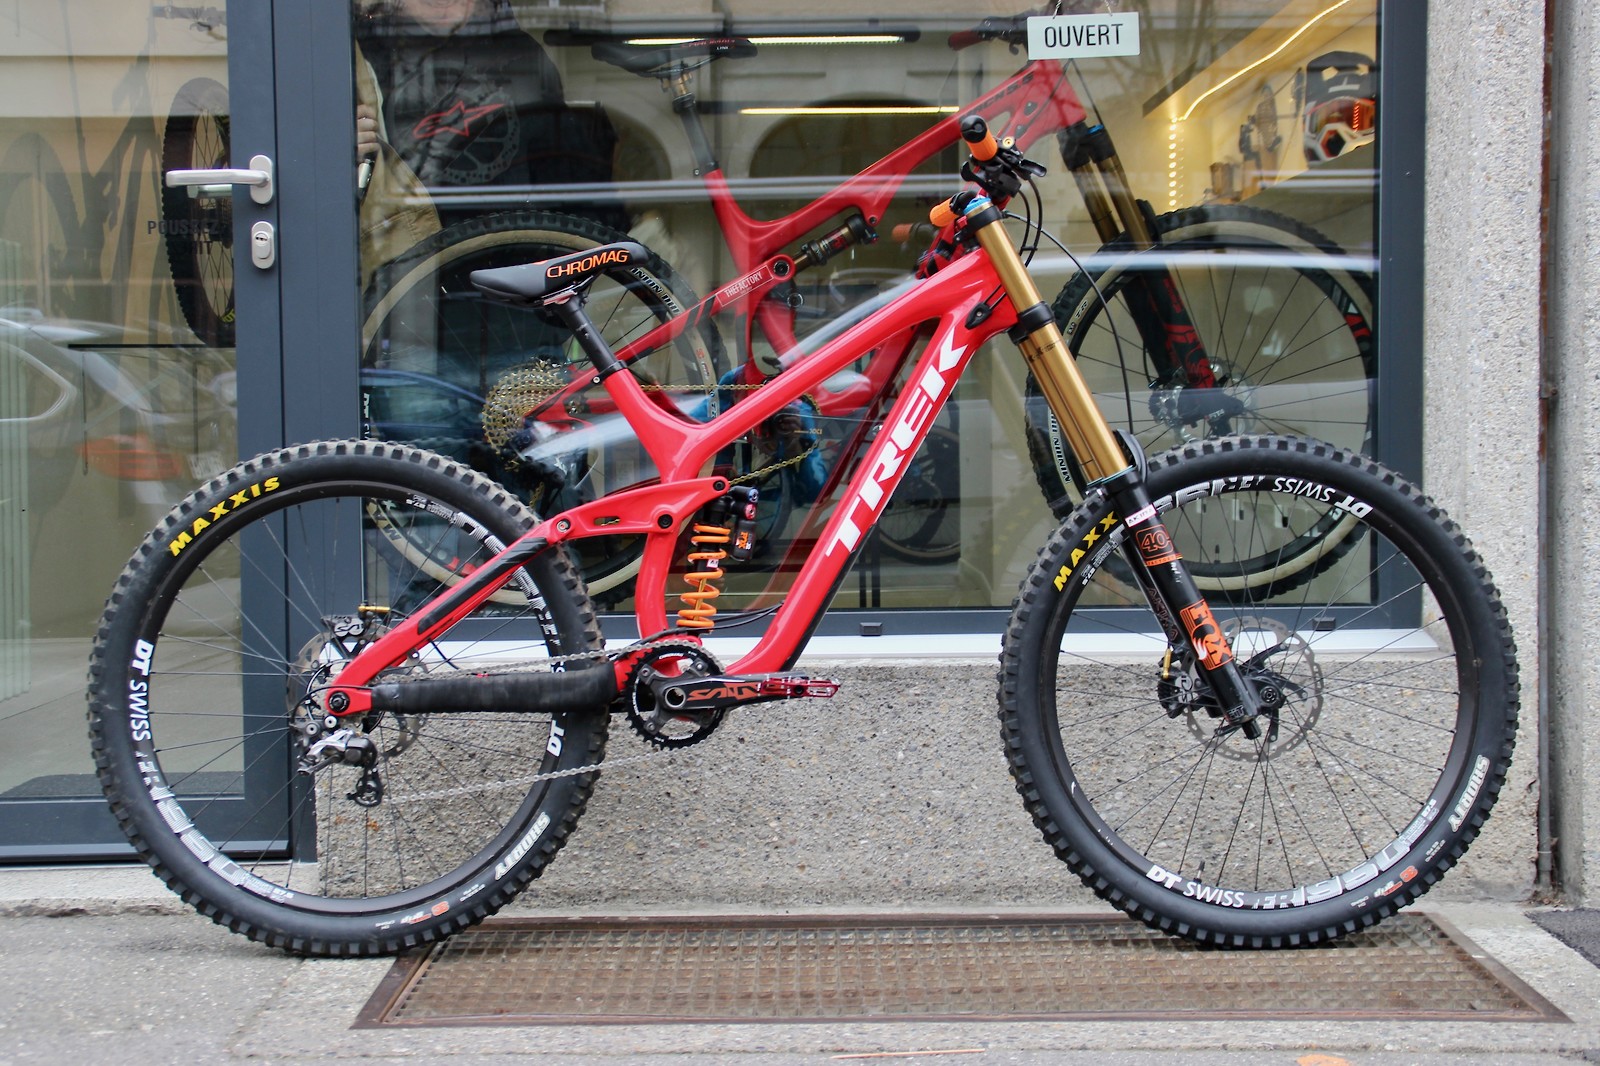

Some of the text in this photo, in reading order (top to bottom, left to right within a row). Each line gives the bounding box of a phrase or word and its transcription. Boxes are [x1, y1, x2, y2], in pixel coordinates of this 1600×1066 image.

[1044, 23, 1123, 48] OUVERT
[546, 249, 630, 279] CHROMAG
[825, 326, 969, 558] TREK
[1272, 476, 1336, 503] SWISS
[1334, 495, 1374, 519] DT
[168, 477, 280, 557] MAXXIS
[1139, 528, 1170, 552] 40
[1190, 600, 1234, 668] FOX
[132, 639, 154, 676] DT
[128, 679, 151, 742] SWISS
[546, 719, 565, 757] DT
[1448, 754, 1490, 832] SHORTY
[494, 811, 551, 881] SHORTY
[1146, 864, 1182, 889] DT
[1183, 881, 1245, 908] SWISS
